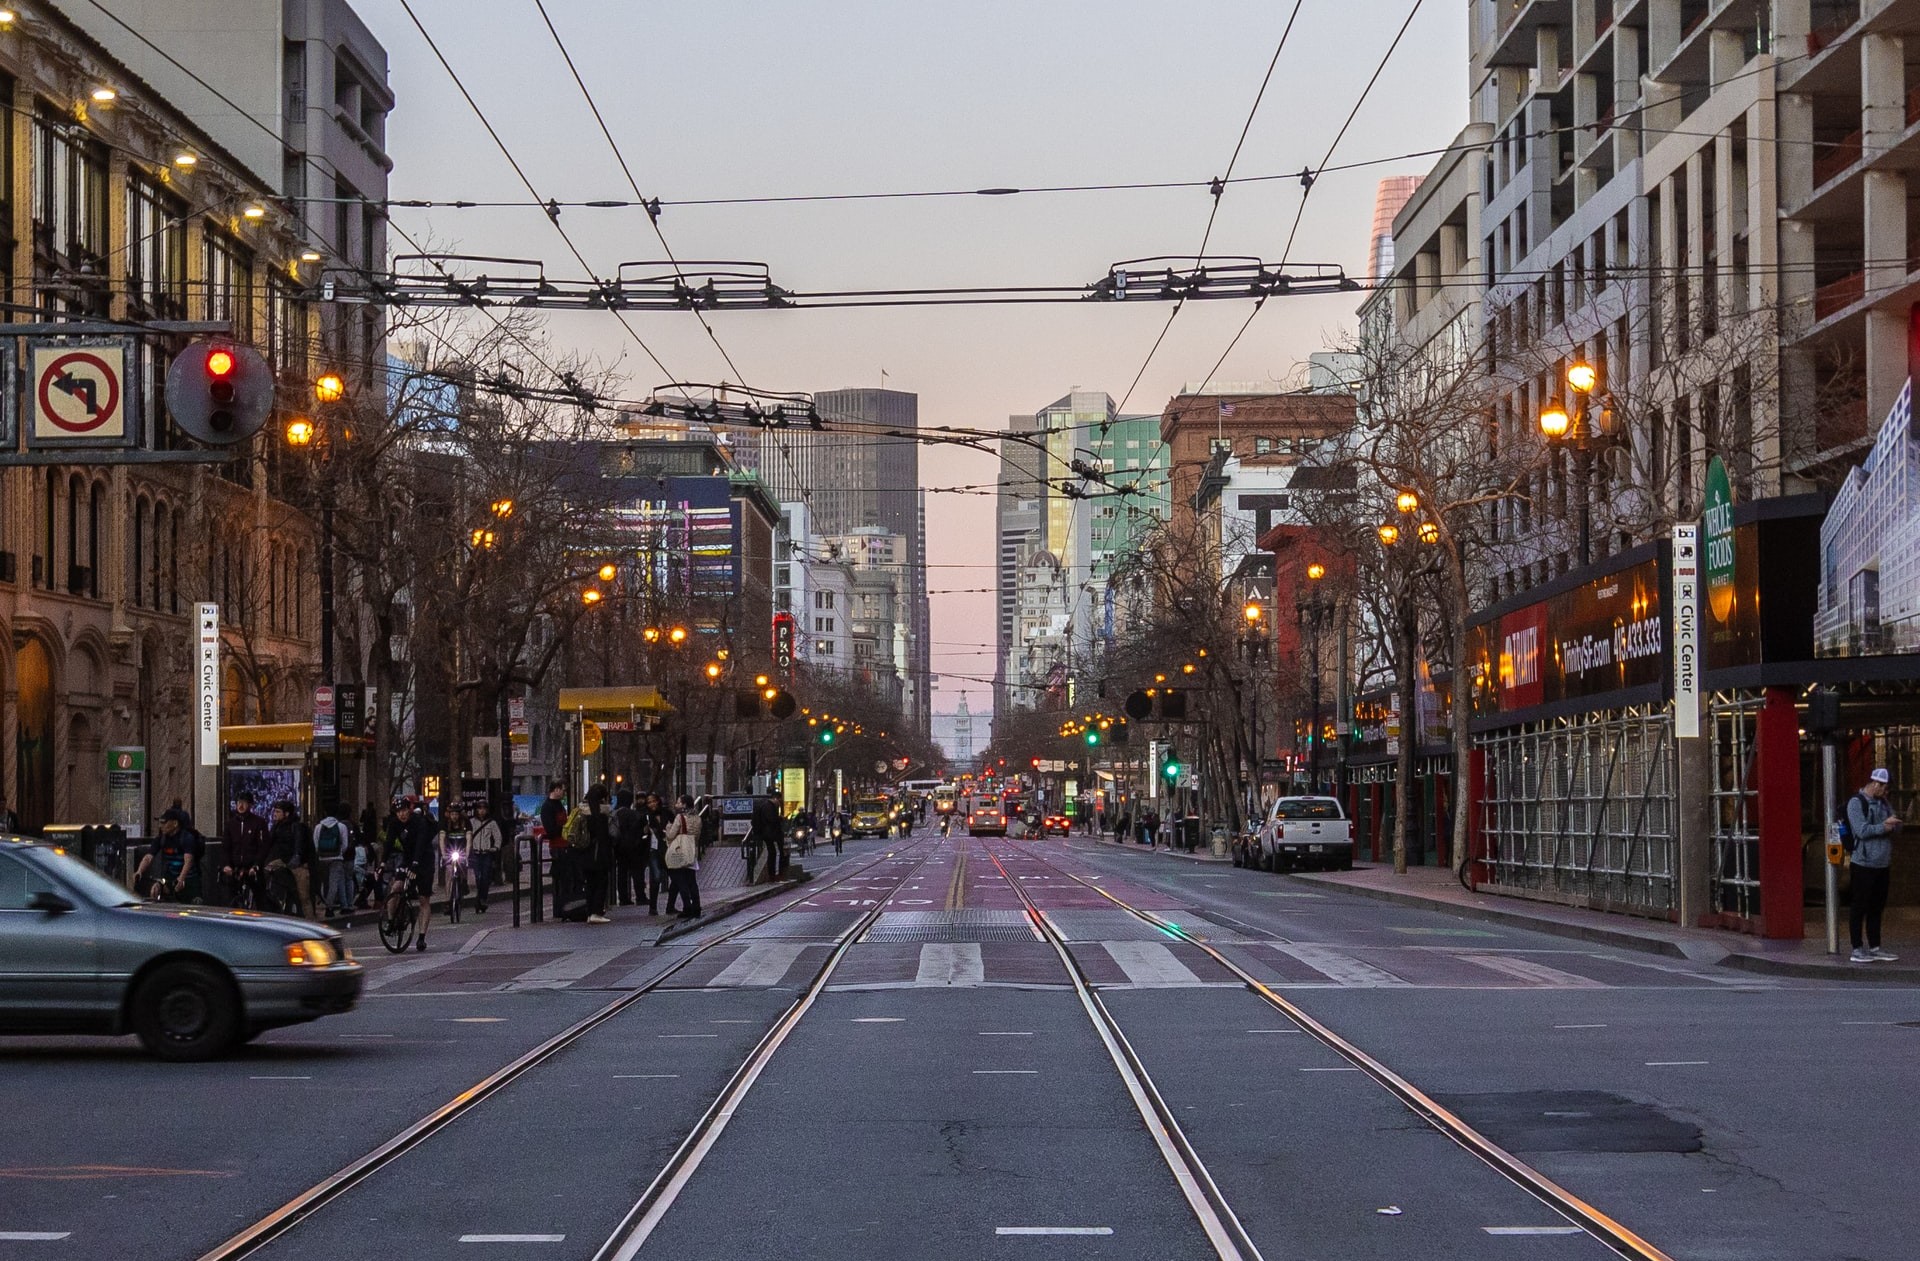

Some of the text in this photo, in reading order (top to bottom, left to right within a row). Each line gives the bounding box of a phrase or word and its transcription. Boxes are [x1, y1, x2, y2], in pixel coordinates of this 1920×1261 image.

[1705, 502, 1732, 538] WHOLE
[1708, 536, 1733, 571] FOODS
[1711, 573, 1730, 586] MARKET
[1512, 626, 1538, 687] TRINITY
[1562, 634, 1611, 679] TrinitySF.com
[1681, 605, 1694, 694] Civic Center
[203, 665, 213, 732] Civic Center
[608, 722, 629, 730] RAPID
